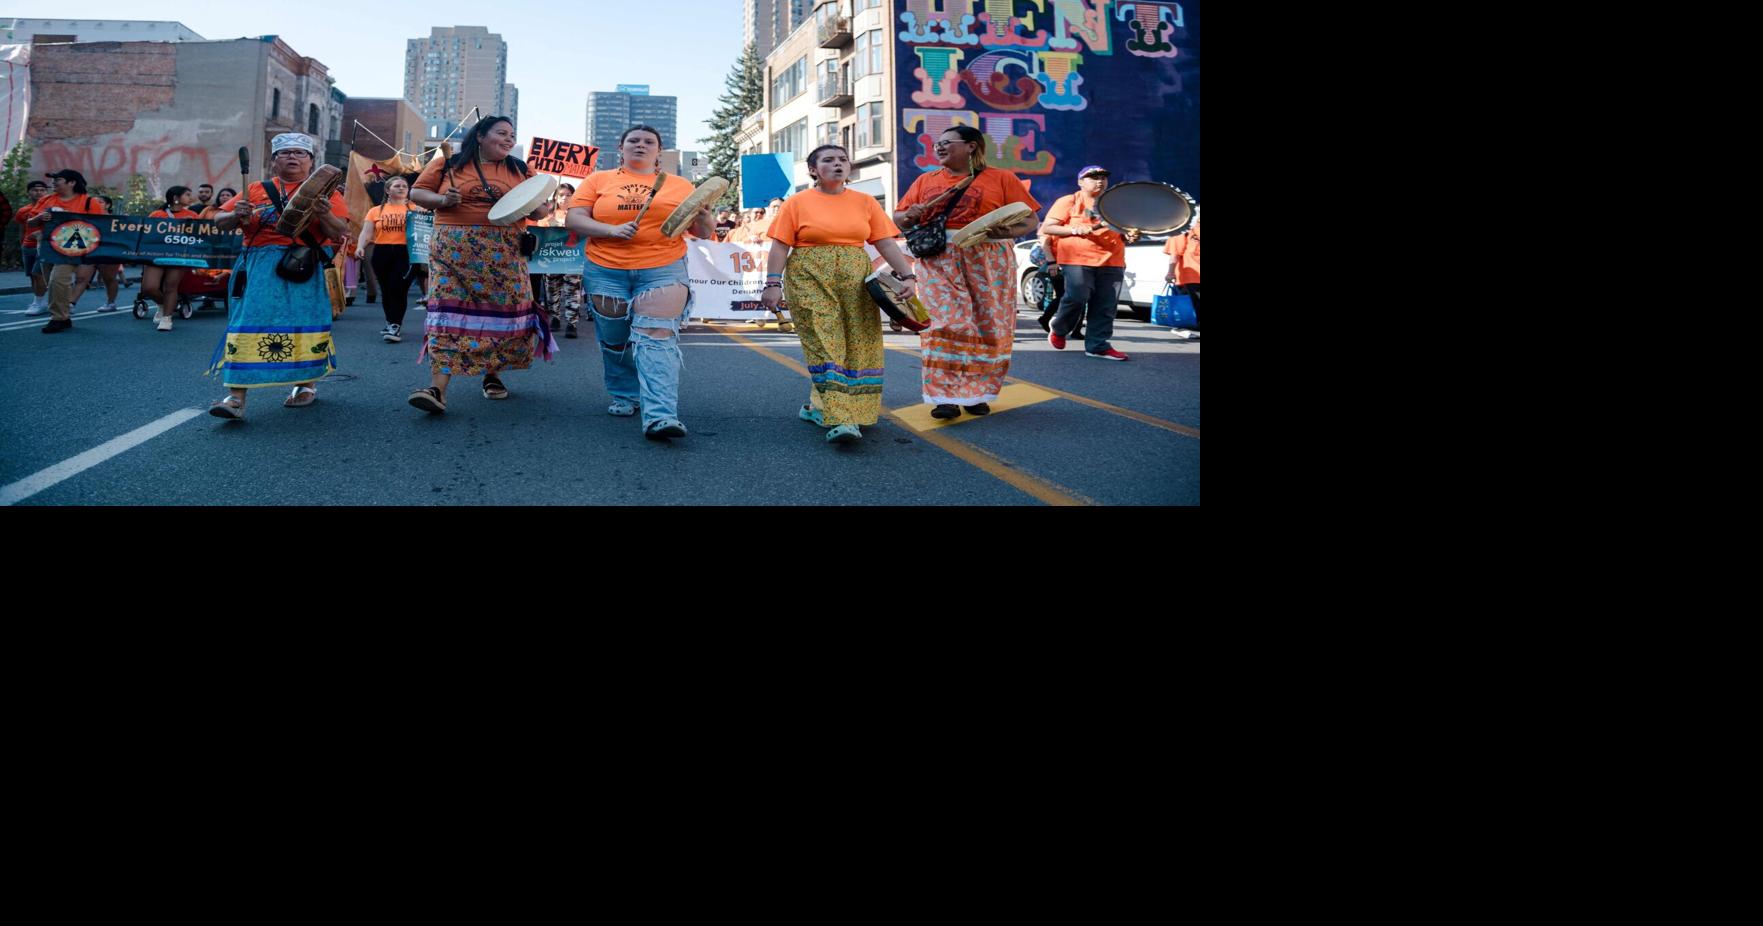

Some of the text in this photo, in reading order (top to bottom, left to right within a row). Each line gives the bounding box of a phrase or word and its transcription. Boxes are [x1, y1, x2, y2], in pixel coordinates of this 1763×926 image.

[912, 47, 1088, 111] ICI
[531, 137, 599, 166] EVERY
[111, 219, 152, 233] Every
[156, 221, 194, 234] Child
[164, 235, 204, 245] 6509+
[539, 246, 580, 257] iskweu
[729, 251, 768, 273] 132
[741, 302, 759, 310] July
